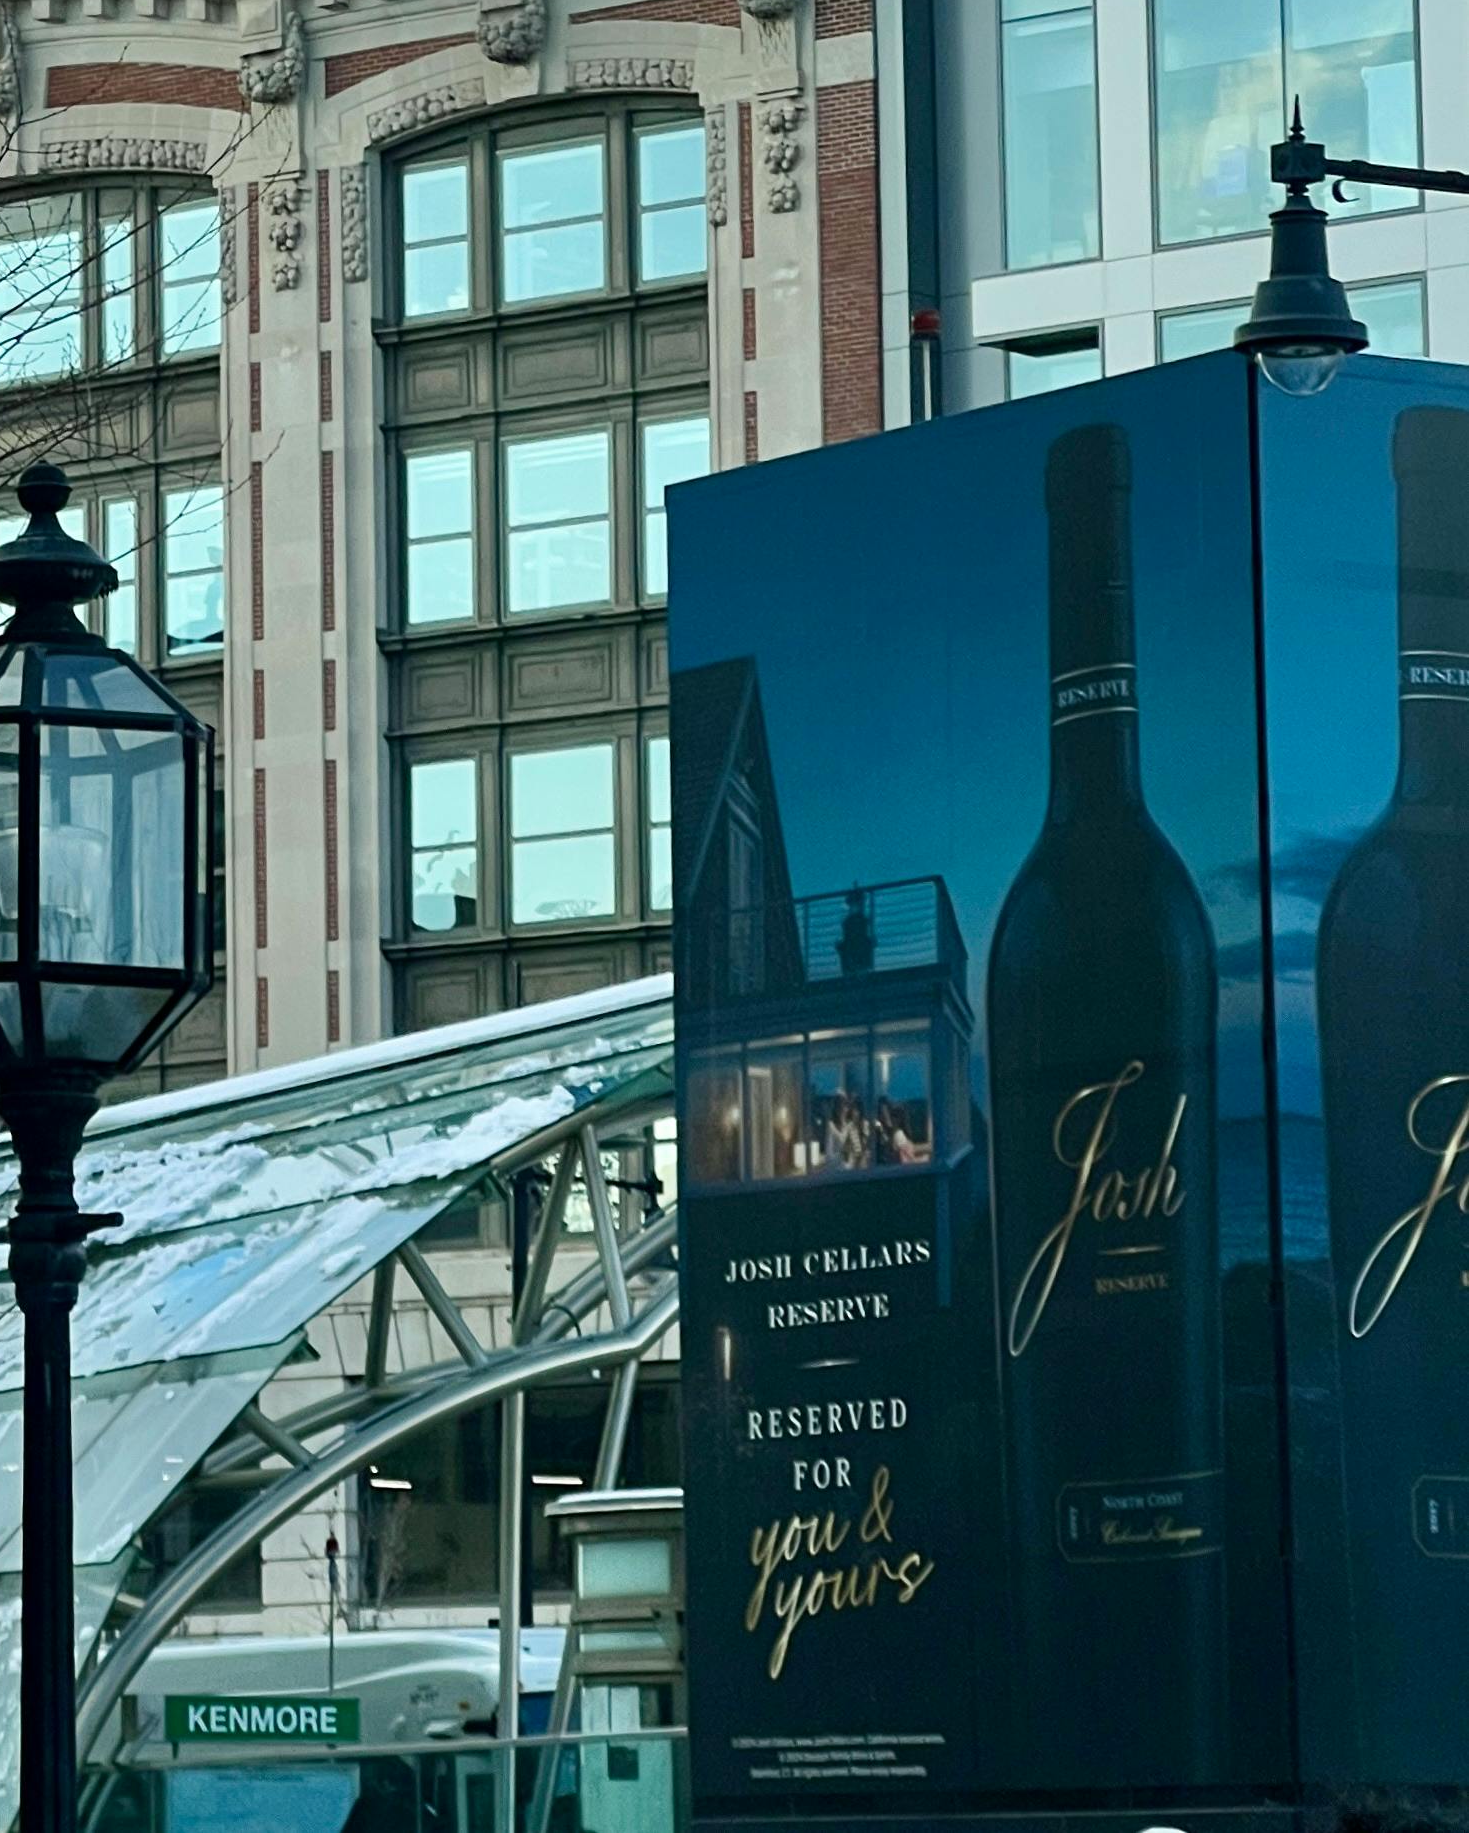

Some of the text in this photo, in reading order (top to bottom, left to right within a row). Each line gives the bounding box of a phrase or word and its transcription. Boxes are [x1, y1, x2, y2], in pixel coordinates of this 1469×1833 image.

[1058, 679, 1130, 708] RESERVE
[1009, 1060, 1187, 1357] Josh
[724, 1239, 931, 1284] JOSH CELLARS
[1095, 1272, 1170, 1295] RESERVE
[767, 1292, 890, 1329] RESERVE
[748, 1397, 908, 1440] RESERVED
[793, 1457, 851, 1491] FOR
[745, 1466, 894, 1632] you &
[769, 1552, 934, 1680] yours
[188, 1704, 338, 1734] KENMORE
